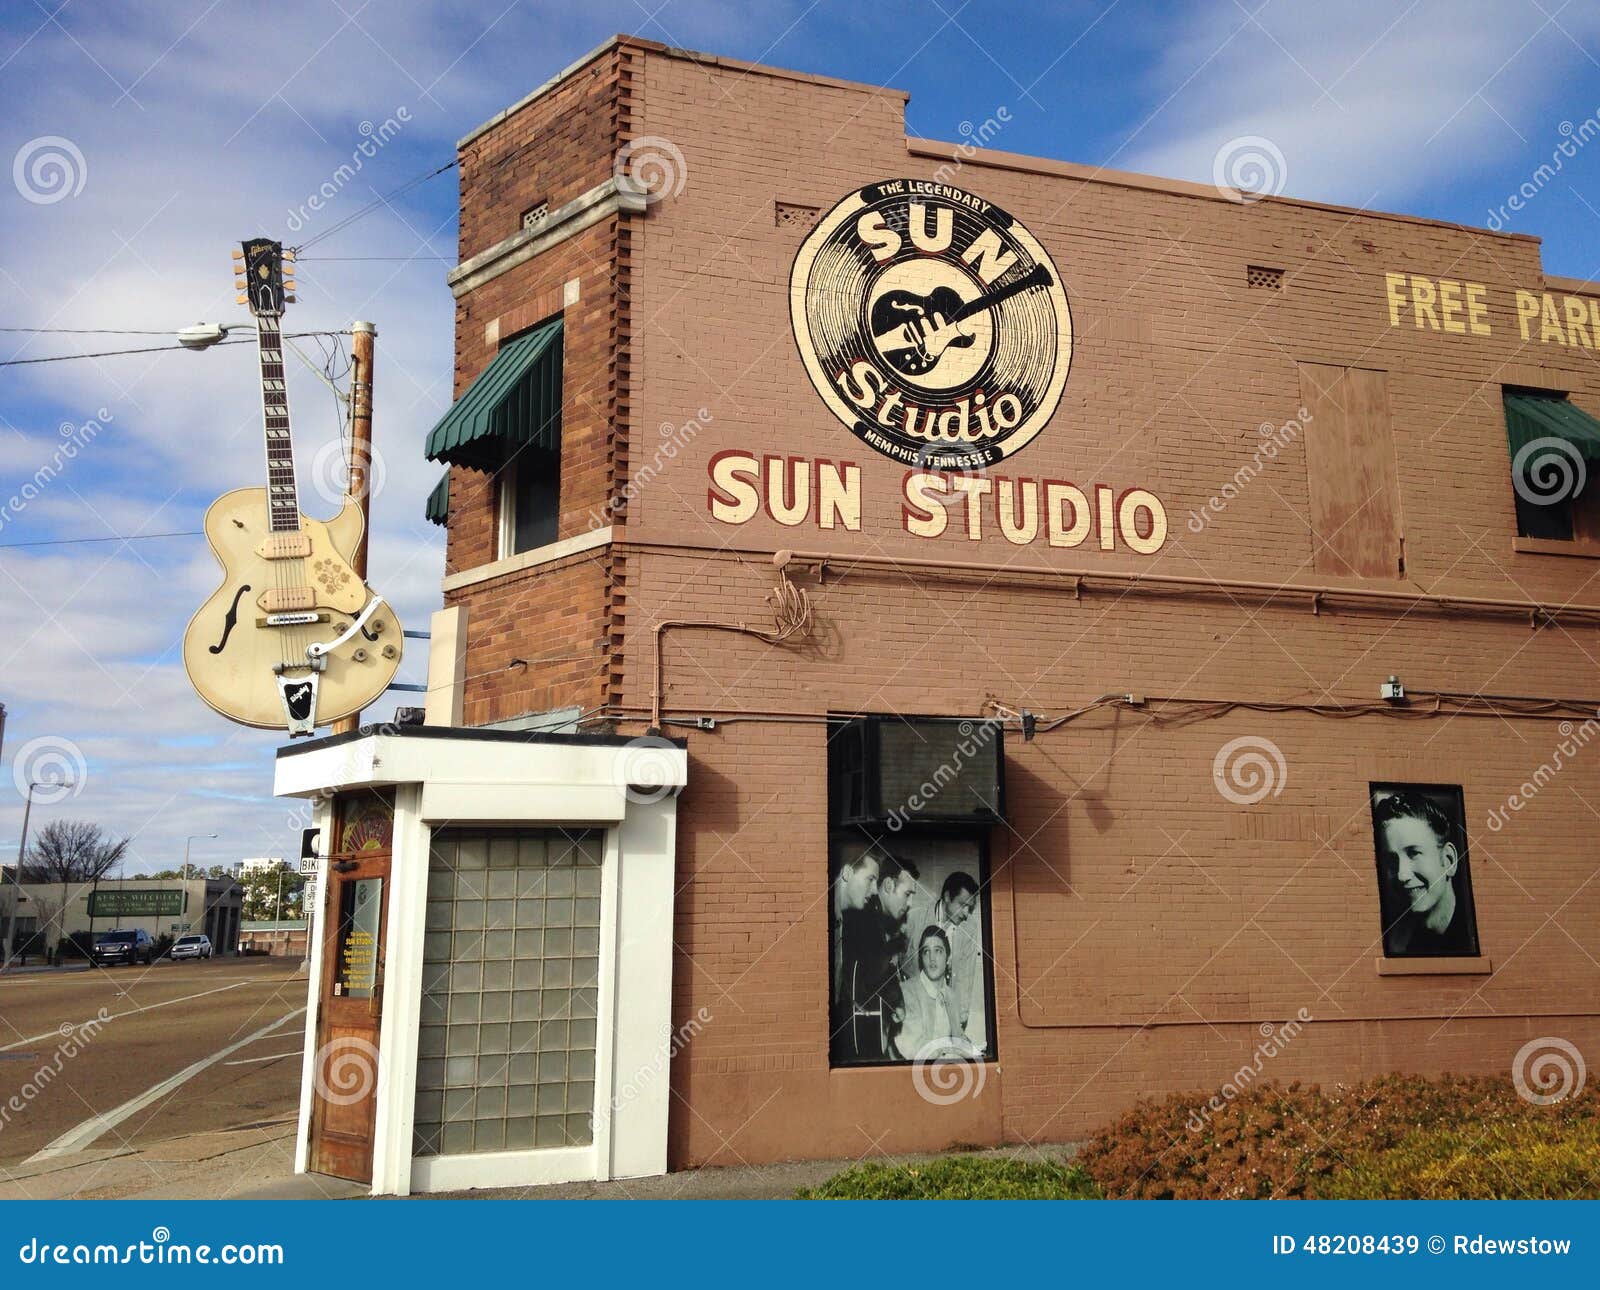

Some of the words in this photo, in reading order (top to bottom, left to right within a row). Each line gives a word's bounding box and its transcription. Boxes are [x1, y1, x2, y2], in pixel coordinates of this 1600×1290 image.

[878, 181, 904, 196] THE
[908, 181, 991, 214] LEGENDARY
[857, 204, 1018, 287] SUN
[1385, 272, 1492, 336] FREE
[835, 356, 1023, 443] Studio
[926, 450, 994, 468] TENNESSEE
[707, 449, 862, 531] SUN
[903, 469, 1169, 555] STUDIO
